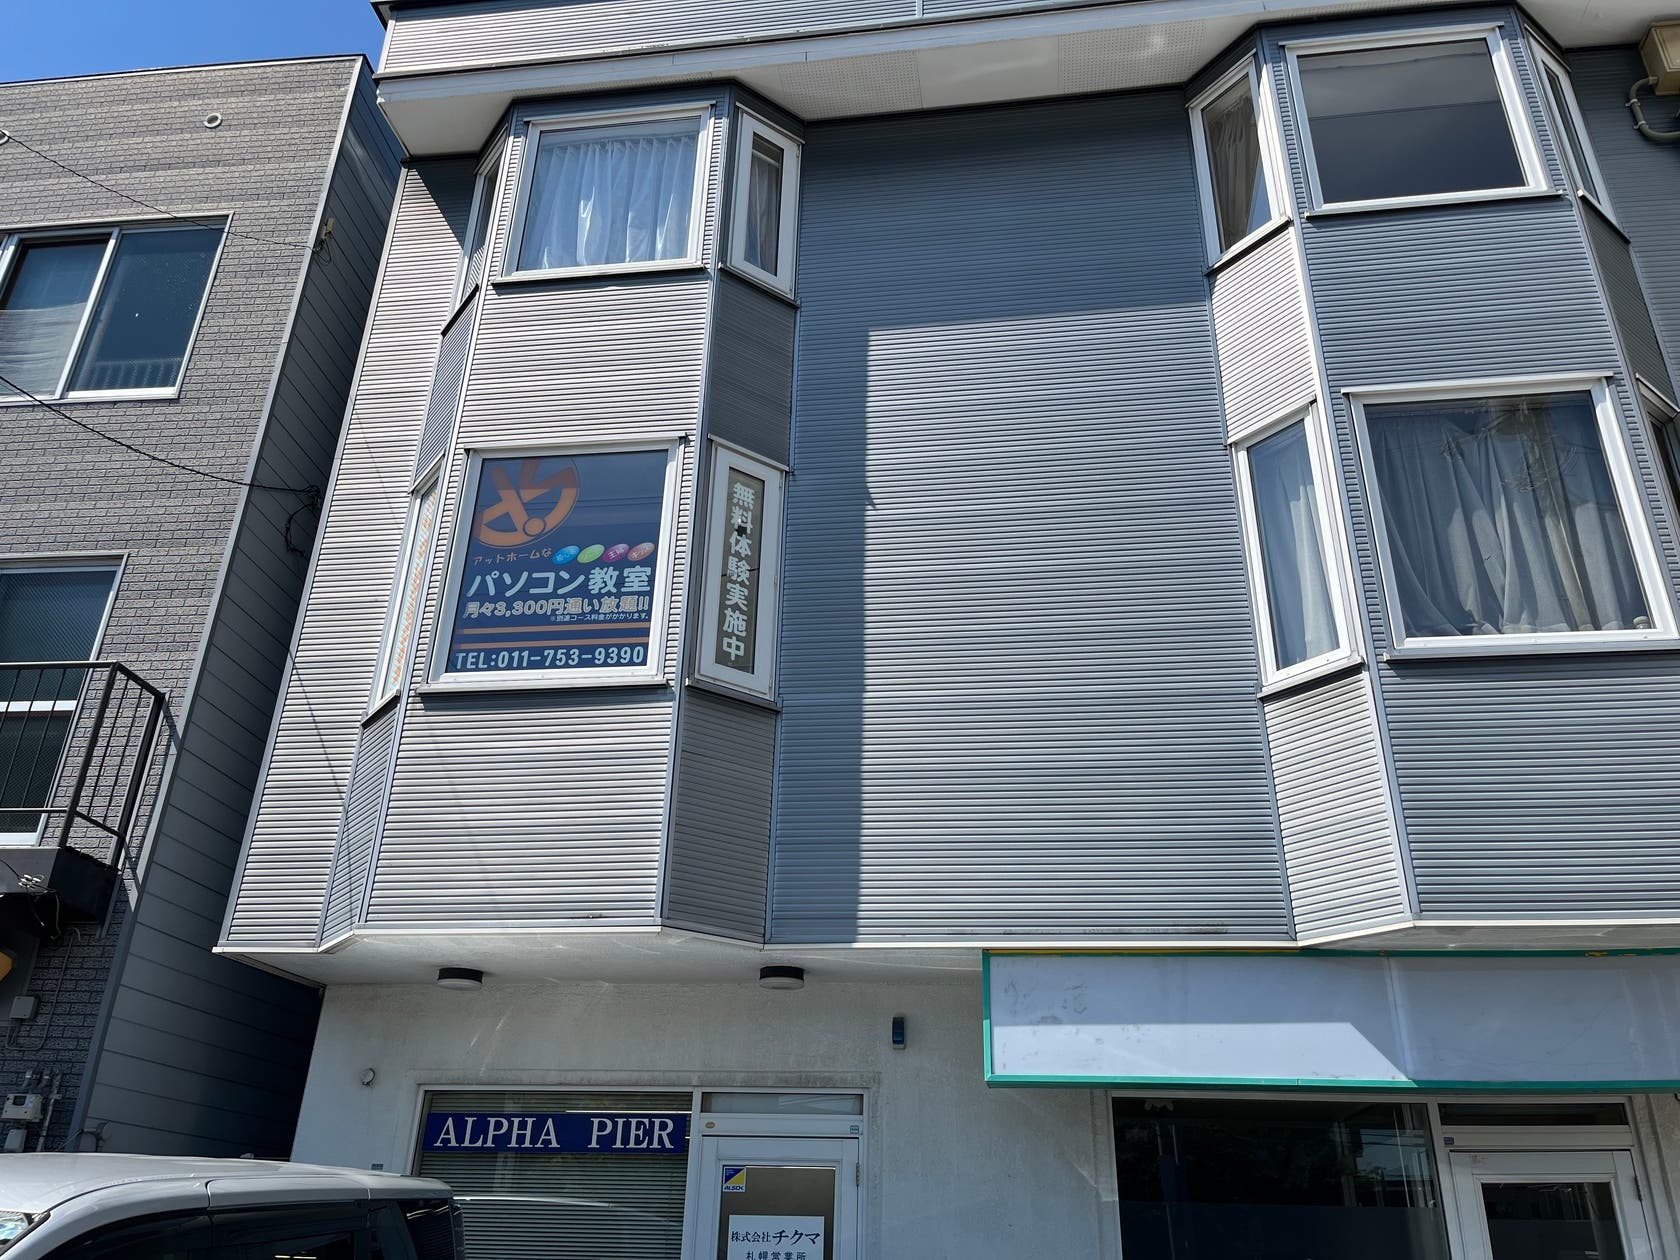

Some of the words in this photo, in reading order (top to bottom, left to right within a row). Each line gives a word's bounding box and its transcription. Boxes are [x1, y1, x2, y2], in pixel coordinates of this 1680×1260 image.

[473, 547, 552, 566] アットホームな
[722, 482, 755, 661] 無料体験実施中
[466, 565, 652, 597] パソコン教室
[455, 646, 644, 669] TEL:011-753-9390
[433, 1117, 561, 1148] ALPHA
[587, 1117, 675, 1149] PIER
